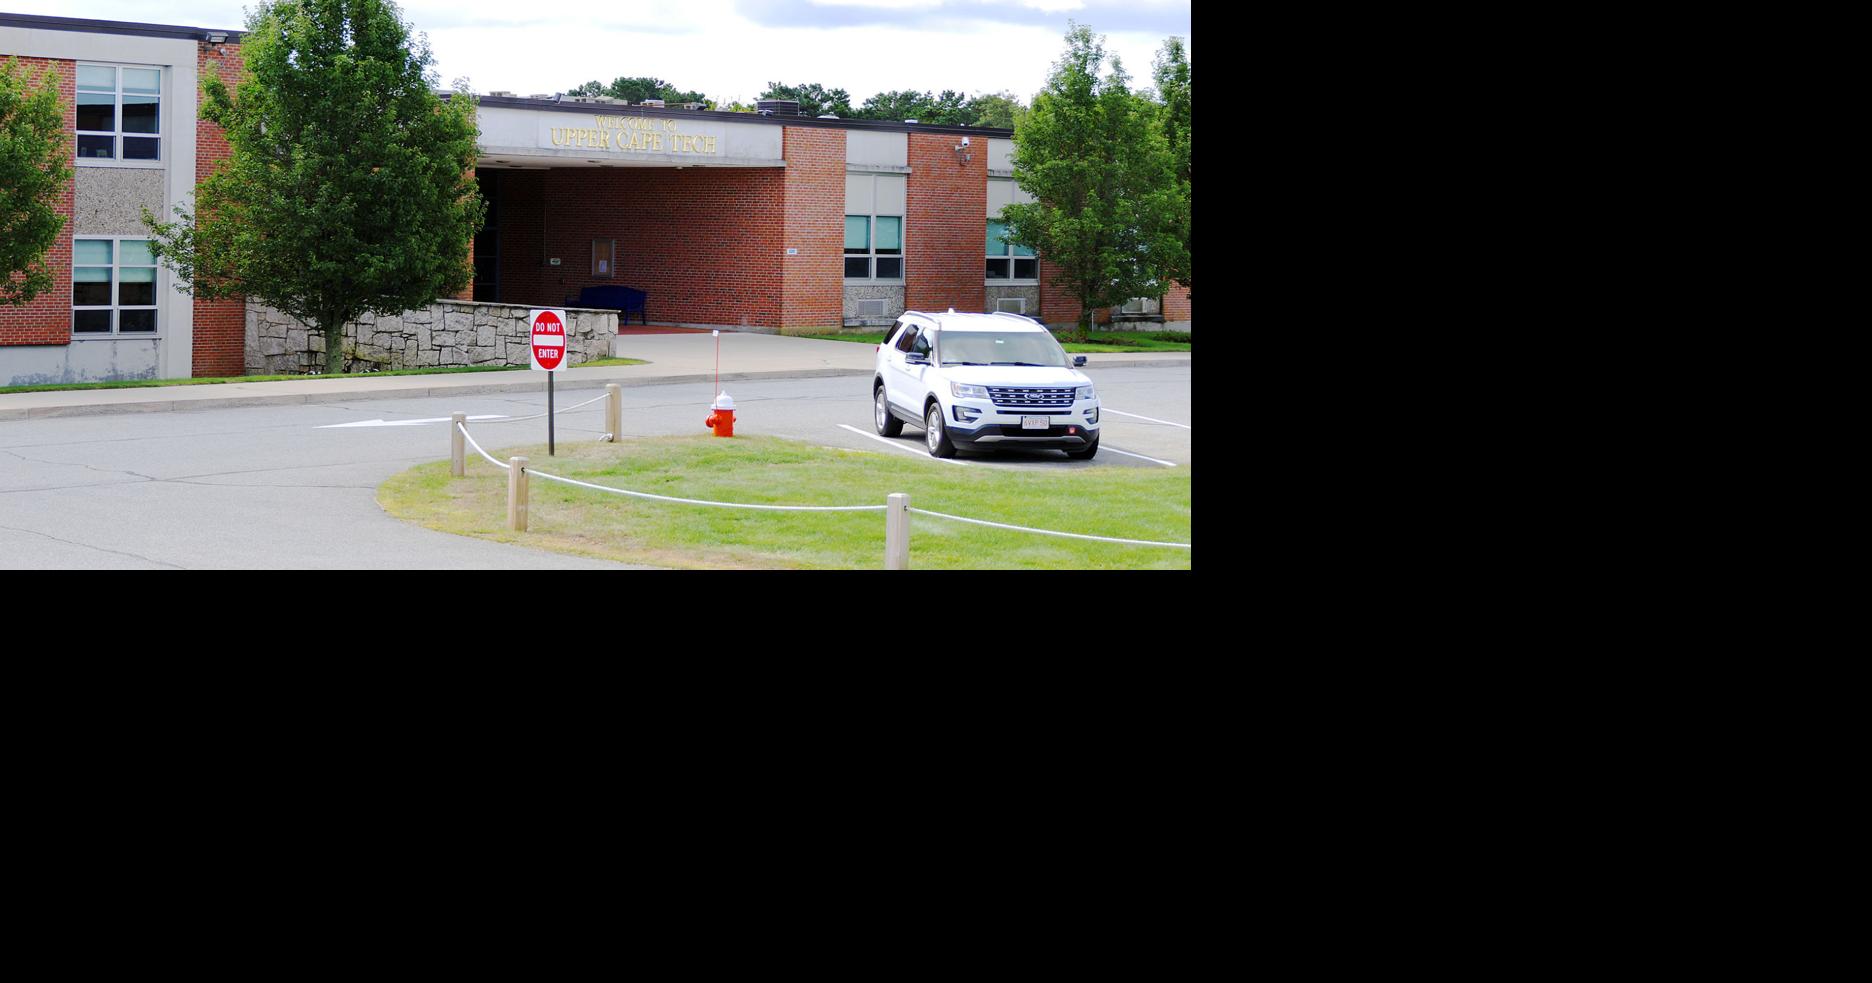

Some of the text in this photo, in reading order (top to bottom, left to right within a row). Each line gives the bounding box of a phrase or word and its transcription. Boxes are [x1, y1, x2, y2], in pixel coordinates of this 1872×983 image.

[595, 115, 677, 131] WELCOME TO
[551, 127, 717, 153] UPPER CAPE TECH
[536, 322, 560, 332] DO NOT
[538, 349, 559, 359] ENTER
